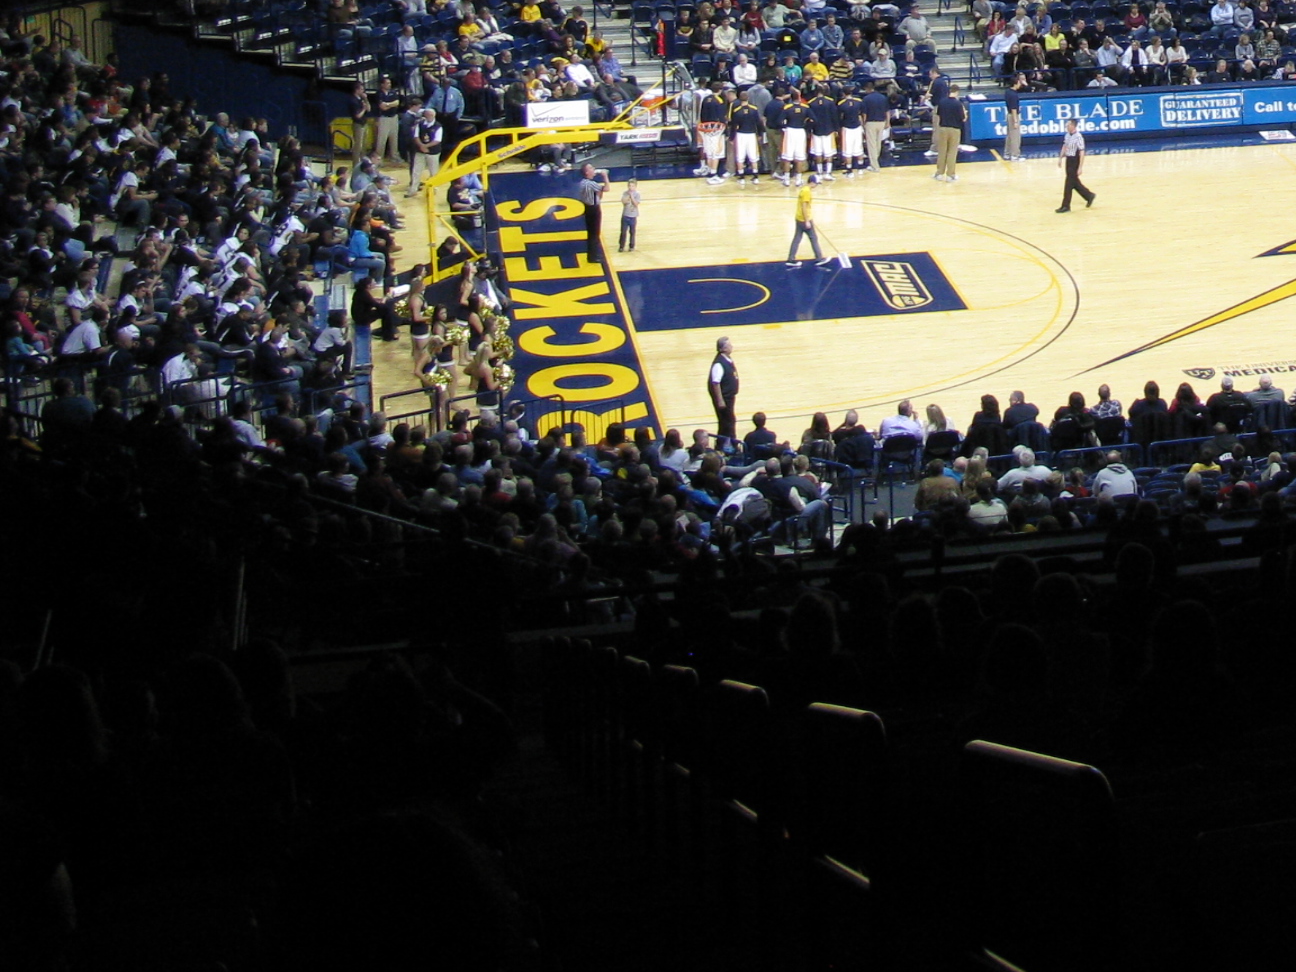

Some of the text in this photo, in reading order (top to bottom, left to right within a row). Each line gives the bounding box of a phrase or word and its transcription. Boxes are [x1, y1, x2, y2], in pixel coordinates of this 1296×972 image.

[1055, 99, 1144, 120] BLADE
[1164, 98, 1237, 110] GUARANTEED
[1254, 101, 1283, 113] Call
[531, 115, 565, 124] verizon
[1165, 107, 1242, 122] DELIVERY
[872, 263, 920, 296] MAC
[496, 196, 657, 448] ROCKETS
